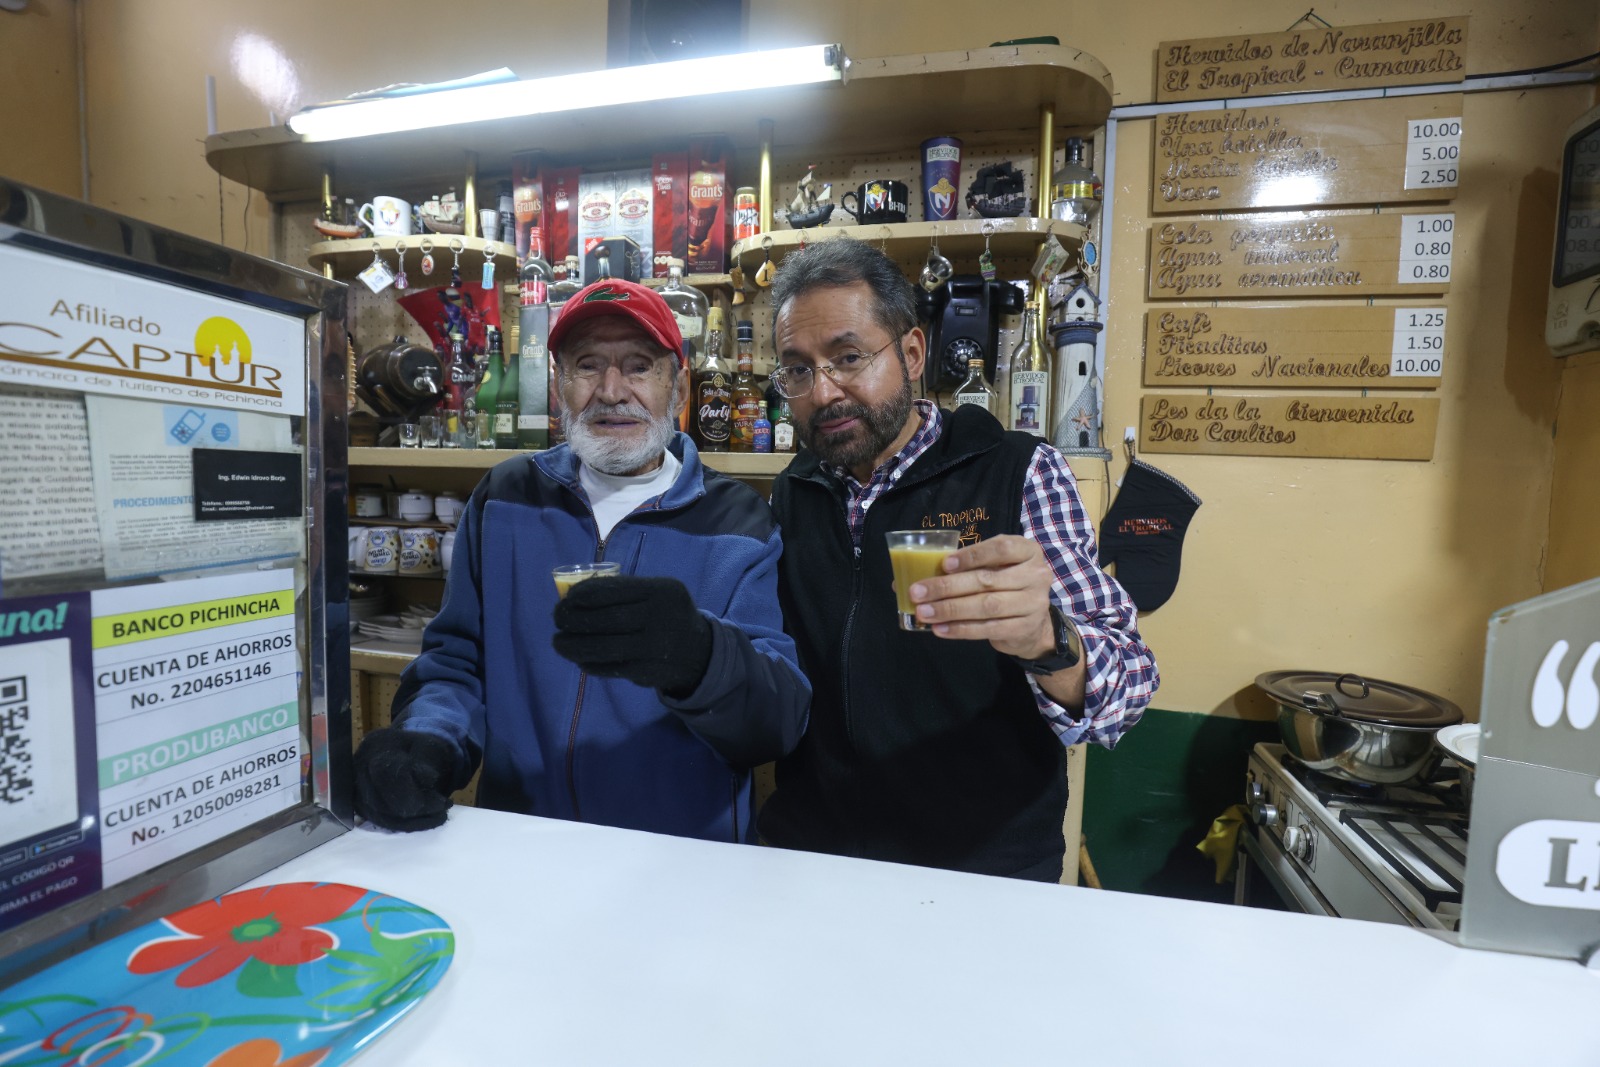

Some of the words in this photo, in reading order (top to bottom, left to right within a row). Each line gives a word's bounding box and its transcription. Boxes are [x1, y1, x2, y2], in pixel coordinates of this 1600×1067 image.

[1165, 39, 1272, 66] Hervidos
[1281, 35, 1309, 57] de
[1313, 22, 1462, 55] Naranjilla
[1163, 70, 1189, 92] El
[1198, 60, 1305, 93] Tropical
[1413, 122, 1460, 138] 10.00
[1160, 136, 1213, 157] Una
[1220, 130, 1303, 154] botella
[1421, 146, 1458, 161] 5.00
[1160, 156, 1240, 179] Media
[1420, 169, 1457, 184] 2.50
[691, 184, 723, 198] Grant's
[515, 197, 542, 213] Grant's
[1157, 223, 1213, 245] Cola
[1417, 219, 1453, 233] 1.00
[1158, 246, 1222, 272] Agua
[1414, 242, 1451, 256] 0.80
[1157, 266, 1222, 295] Agua
[1413, 264, 1449, 278] 0.80
[50, 299, 161, 336] Afiliado
[1409, 313, 1444, 327] 1.25
[1407, 336, 1443, 350] 1.50
[0, 322, 282, 390] CAPTUR
[1155, 355, 1237, 377] Licores
[1251, 355, 1390, 378] Nacionales
[1395, 359, 1441, 373] 10.00
[84, 375, 112, 386] de
[119, 378, 183, 396] Turismo
[188, 388, 209, 398] de
[214, 391, 283, 408] Pichincha
[699, 404, 730, 421] Party
[1149, 400, 1188, 420] Les
[1196, 399, 1228, 420] da
[1234, 399, 1261, 420] la
[1285, 401, 1414, 424] bienvenida
[1149, 420, 1198, 442] Don
[1204, 421, 1296, 443] Carlitos
[938, 506, 990, 527] TROPICAL
[1124, 518, 1168, 526] HERVIDOS
[1131, 523, 1174, 532] TROPICAL
[112, 613, 183, 638] BANCO
[190, 597, 280, 626] PICHINCHA
[97, 657, 181, 688] CUENTA
[186, 651, 209, 670] DE
[214, 634, 292, 663] AHORROS
[130, 691, 164, 710] No.
[171, 661, 271, 699] 2204651146
[112, 708, 288, 781] PRODUBANCO
[105, 790, 187, 828] CUENTA
[192, 776, 214, 796] DE
[219, 746, 296, 785] AHORROS
[131, 826, 165, 846] No.
[172, 775, 281, 829] 12050098281
[1543, 837, 1600, 892] L
[45, 876, 78, 895] PAGO
